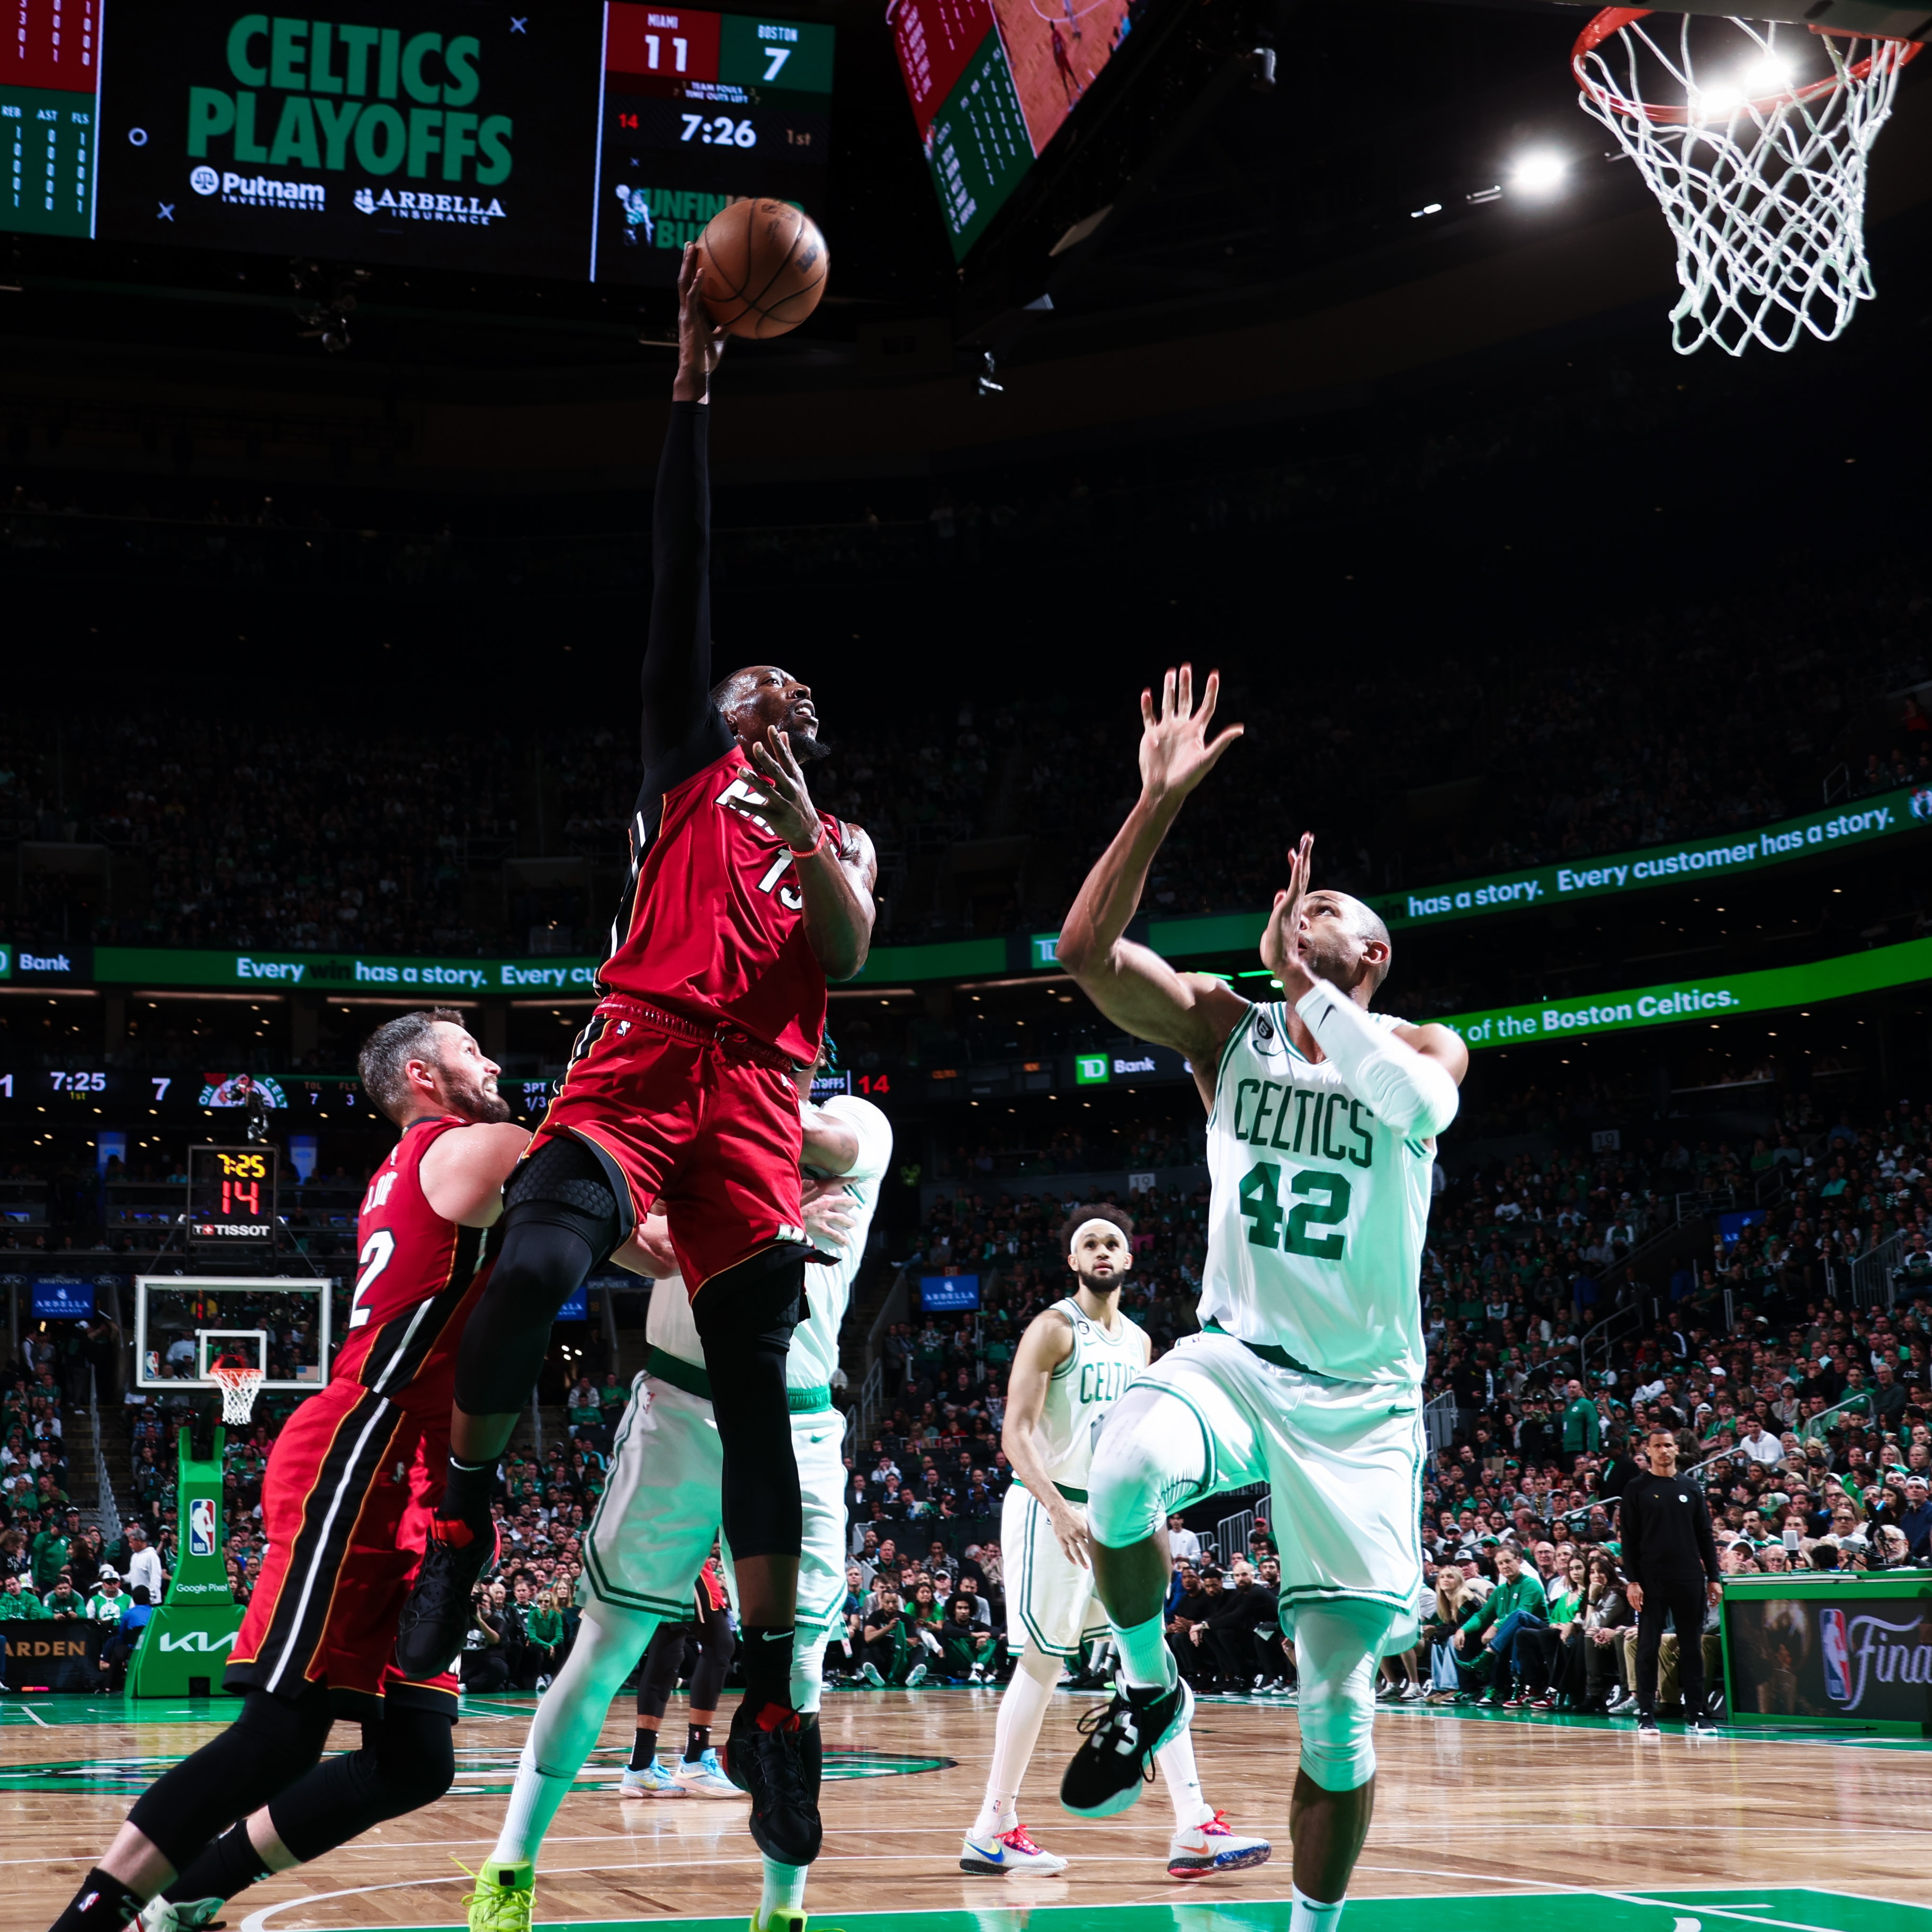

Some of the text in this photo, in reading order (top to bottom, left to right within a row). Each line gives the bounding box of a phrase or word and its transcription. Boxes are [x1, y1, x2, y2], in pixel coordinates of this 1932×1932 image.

[648, 14, 798, 42] MIAMI BOSTON
[227, 14, 480, 106] CELTICS
[645, 34, 791, 81] 11 7
[685, 89, 704, 100] TIME
[730, 94, 749, 104] LEFT
[691, 81, 714, 92] TEAM
[715, 84, 743, 94] FOULS
[36, 109, 58, 122] AST
[71, 112, 90, 124] FLS
[187, 86, 513, 185] PLAYOFFS
[619, 113, 811, 148] 14 7:26 1st
[222, 172, 325, 202] Putnam
[221, 195, 324, 211] INVESTMENTS
[377, 189, 506, 217] ARBELLA
[391, 209, 490, 226] INSURANCE
[1408, 896, 1452, 917] has
[1455, 891, 1471, 909] a
[1475, 880, 1543, 906] story.
[1558, 865, 1629, 892] Every
[1633, 842, 1757, 879] customer
[1761, 830, 1803, 856] has
[1806, 825, 1822, 843] a
[1826, 807, 1894, 839] story.
[20, 954, 70, 971] Bank
[237, 957, 305, 983] Every
[310, 960, 350, 980] win
[355, 960, 398, 982] has
[402, 967, 418, 983] a
[422, 965, 487, 988] story.
[501, 965, 567, 987] Every
[1468, 1020, 1491, 1042] of
[1497, 1016, 1536, 1037] the
[1543, 1003, 1632, 1032] Boston
[1636, 989, 1740, 1017] Celtics.
[1078, 1057, 1156, 1078] TD Bank
[50, 1071, 106, 1092] 7:25
[151, 1078, 171, 1101] 7
[70, 1091, 86, 1101] 1st
[303, 1081, 546, 1094] TOL FLS 3PT
[858, 1074, 891, 1094] 14
[309, 1093, 547, 1112] 7 3 1/3
[1235, 1078, 1374, 1168] CELTICS
[1595, 1133, 1615, 1149] 19
[217, 1153, 265, 1178] 7:25
[222, 1180, 258, 1215] 14
[1239, 1161, 1351, 1261] 42
[217, 1224, 271, 1237] TISSOT
[1080, 1362, 1140, 1404] CELTI
[176, 1583, 228, 1594] Google Pixel
